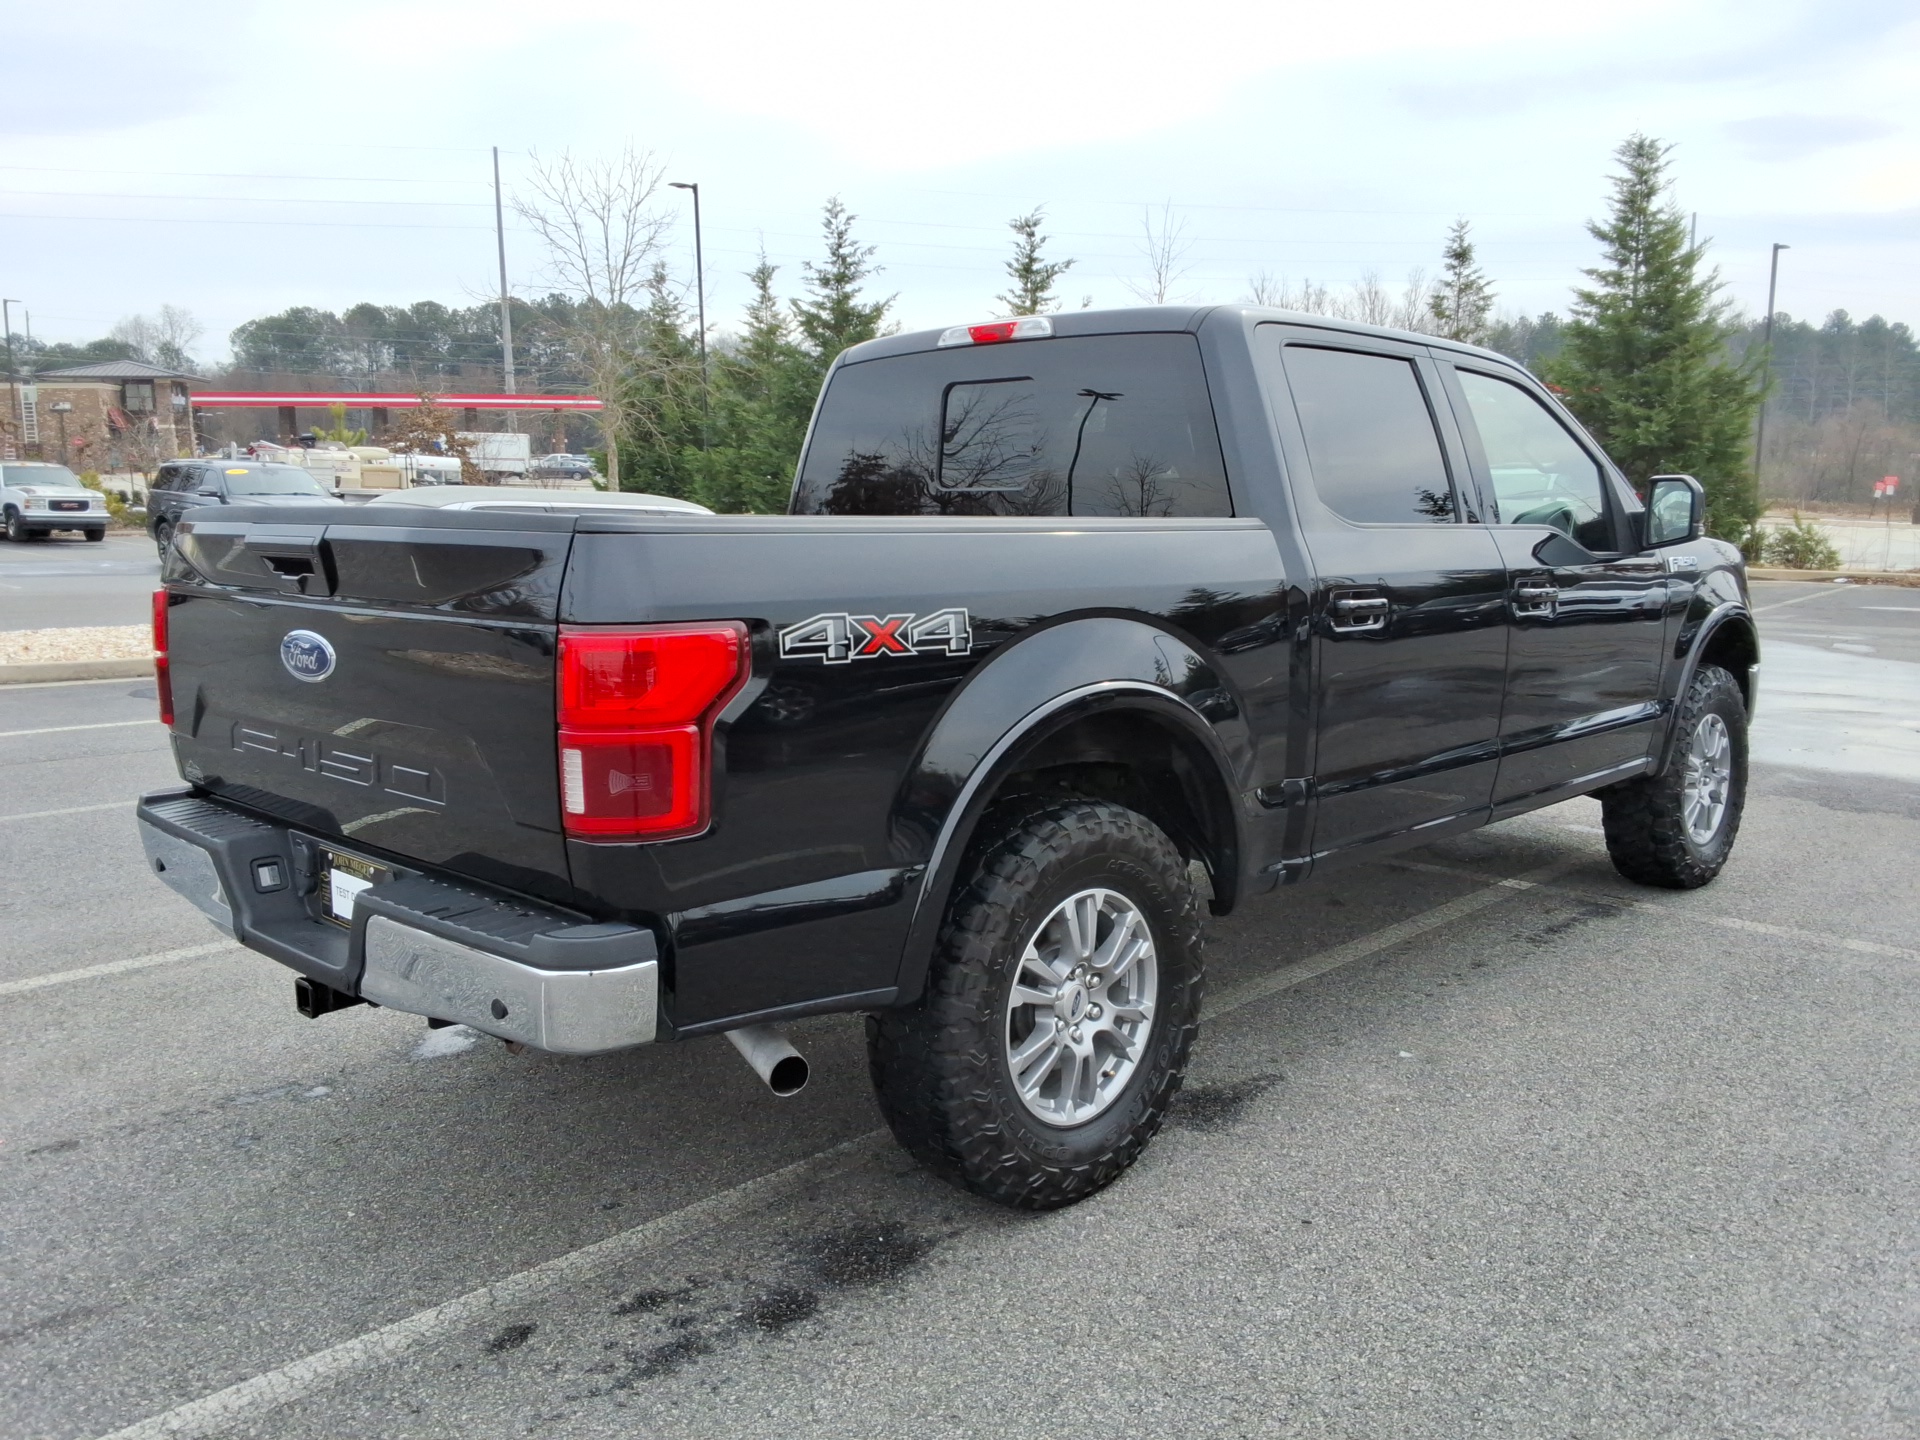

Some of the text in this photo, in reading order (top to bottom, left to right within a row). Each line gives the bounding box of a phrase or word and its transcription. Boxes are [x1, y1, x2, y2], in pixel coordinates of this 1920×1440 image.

[284, 640, 321, 671] Ford
[333, 853, 349, 867] JOHN
[335, 885, 350, 899] TEST
